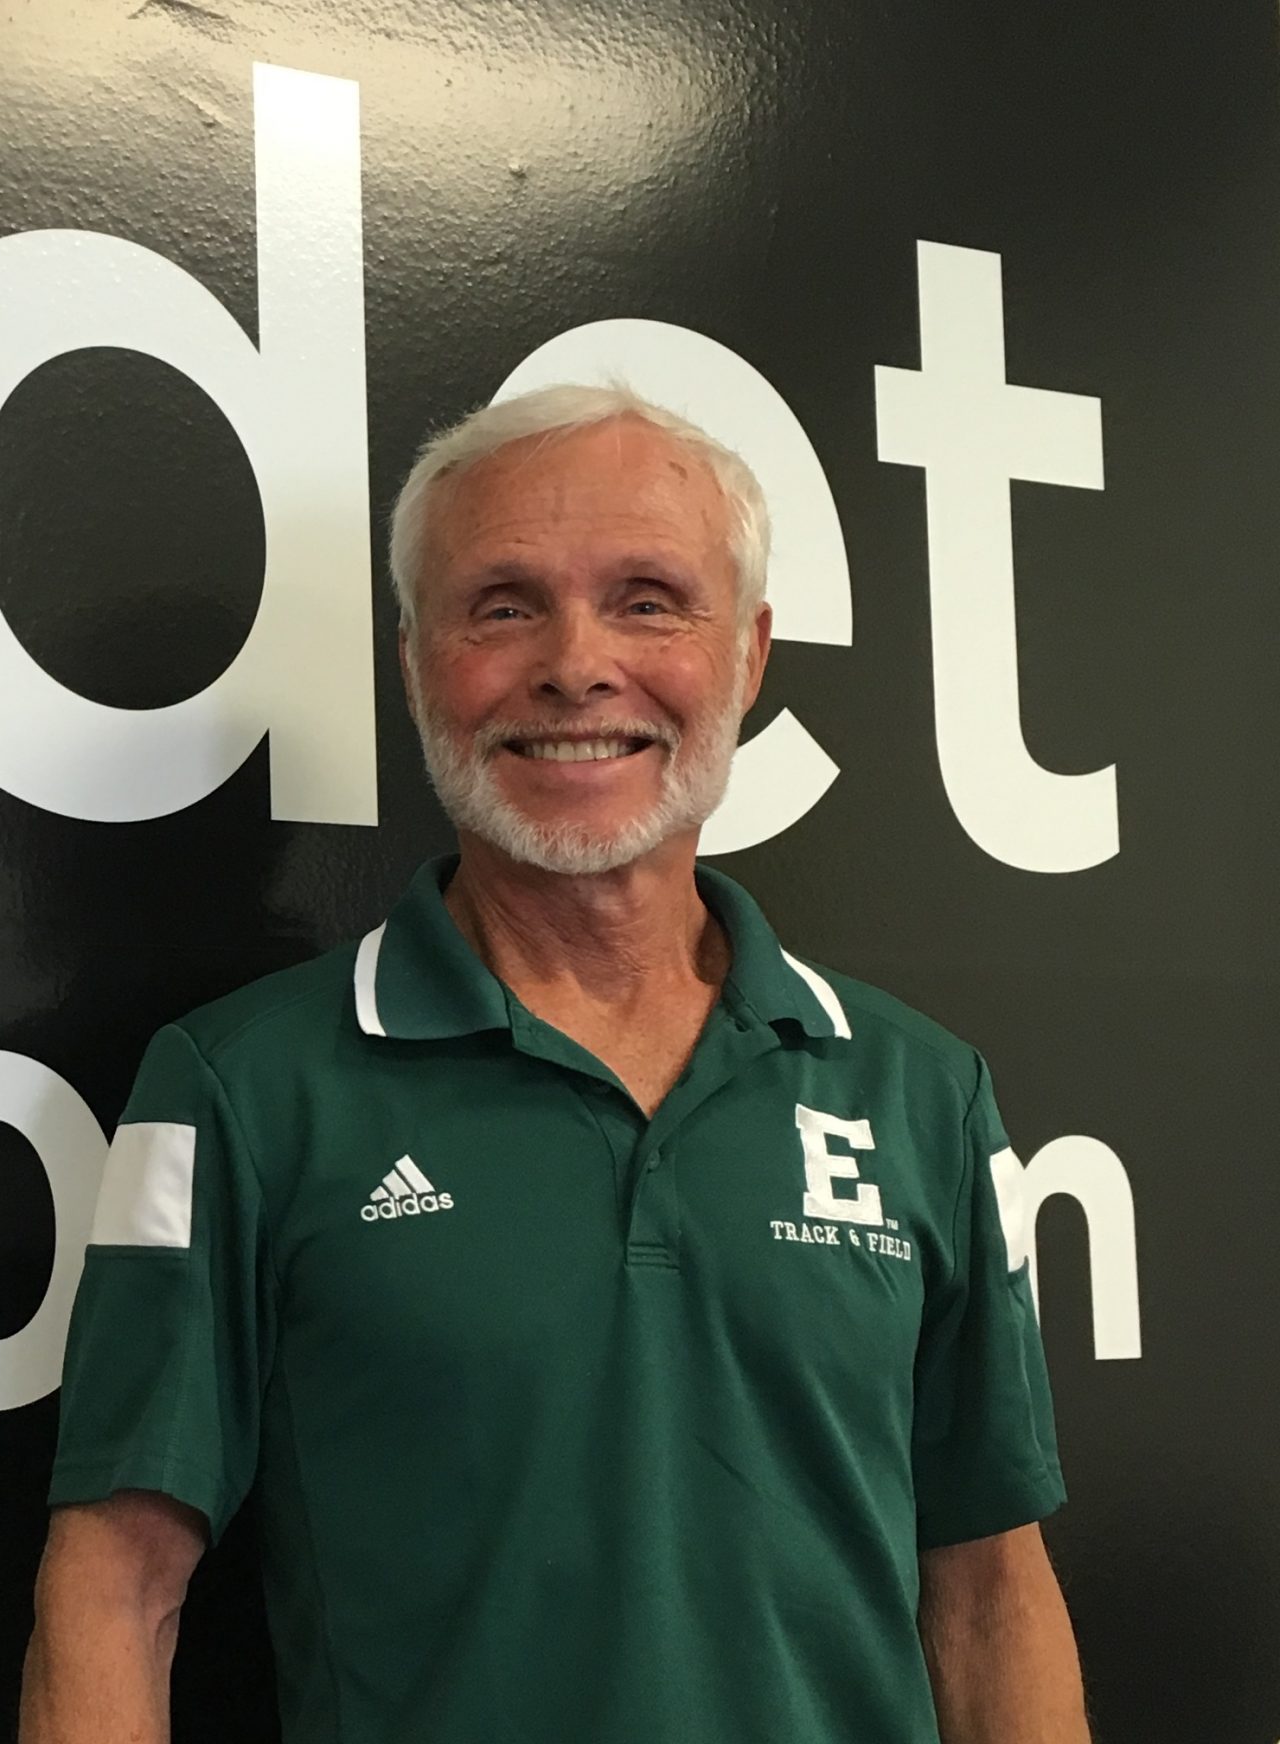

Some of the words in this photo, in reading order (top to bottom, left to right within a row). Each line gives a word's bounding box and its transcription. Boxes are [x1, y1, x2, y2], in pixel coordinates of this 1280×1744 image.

[795, 1103, 884, 1226] E
[360, 1192, 454, 1221] adidas
[770, 1221, 841, 1245] TRACK
[848, 1229, 861, 1247] &
[866, 1232, 912, 1261] FIELD
